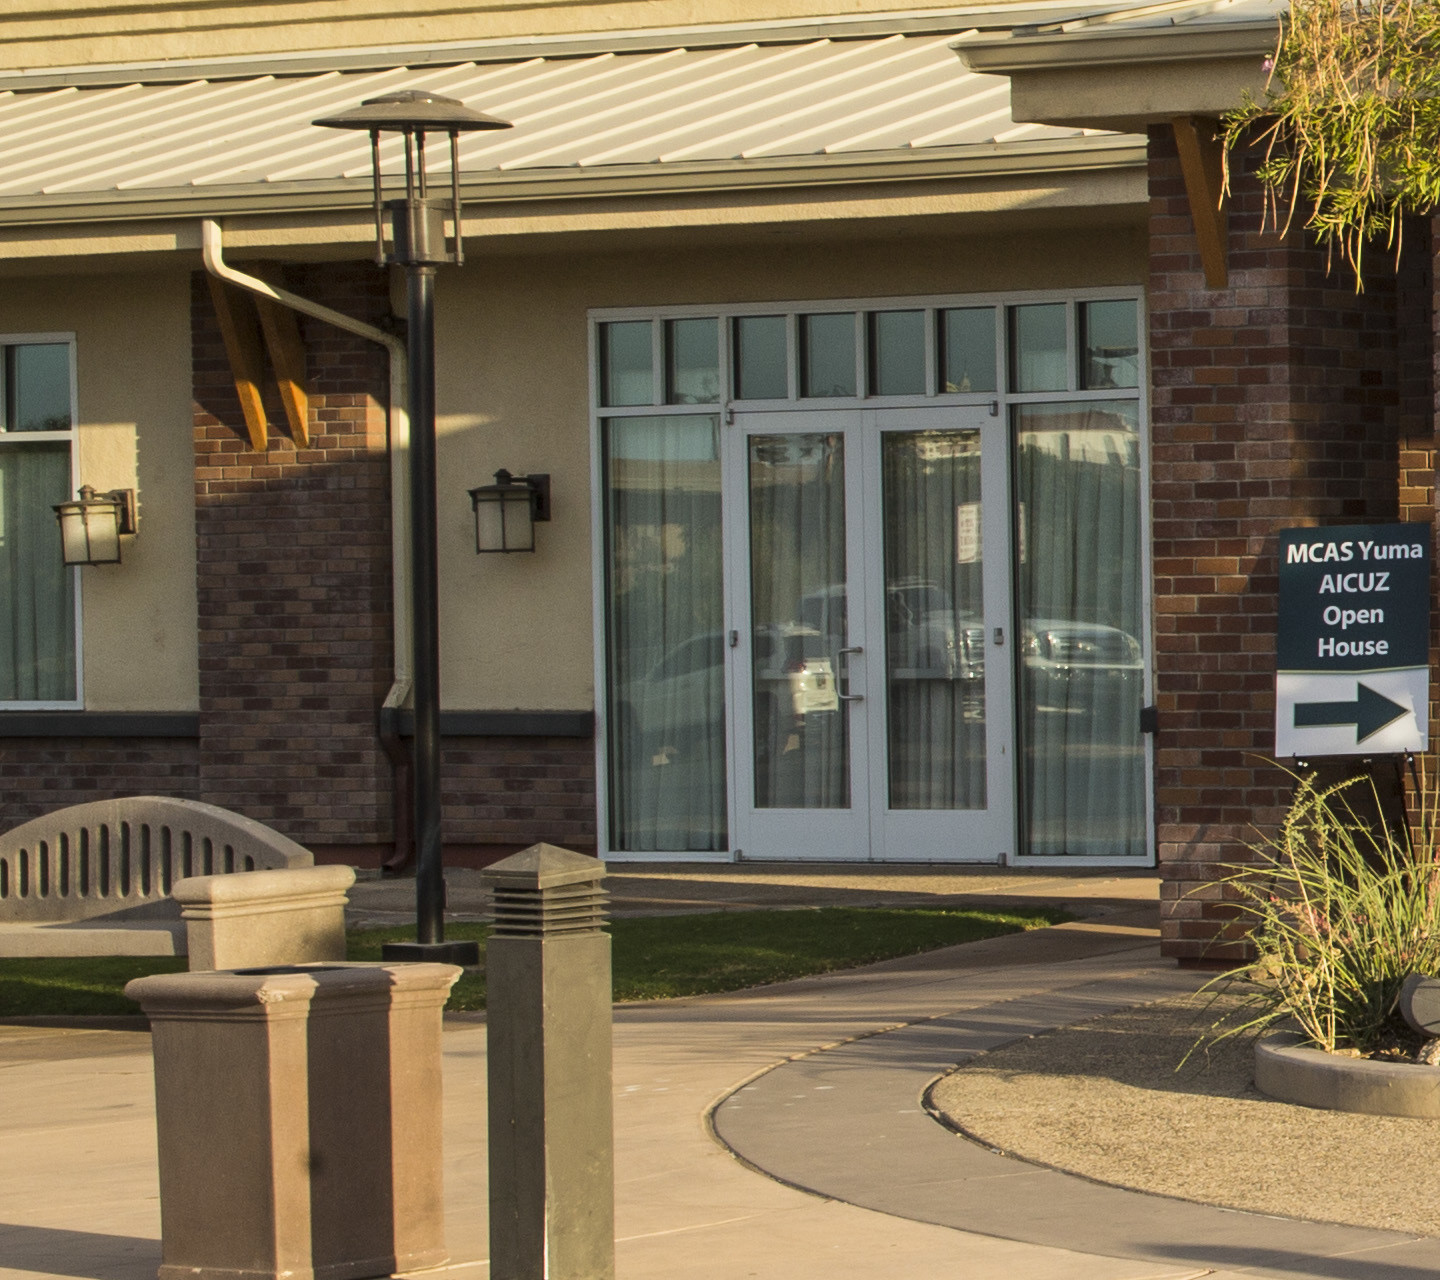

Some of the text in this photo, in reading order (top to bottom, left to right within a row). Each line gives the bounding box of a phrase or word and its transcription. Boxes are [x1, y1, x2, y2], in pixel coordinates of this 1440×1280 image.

[1287, 541, 1423, 564] MCAS Yuma
[1318, 572, 1390, 594] AICUZ
[1323, 606, 1384, 630] Open
[1318, 638, 1389, 657] House
